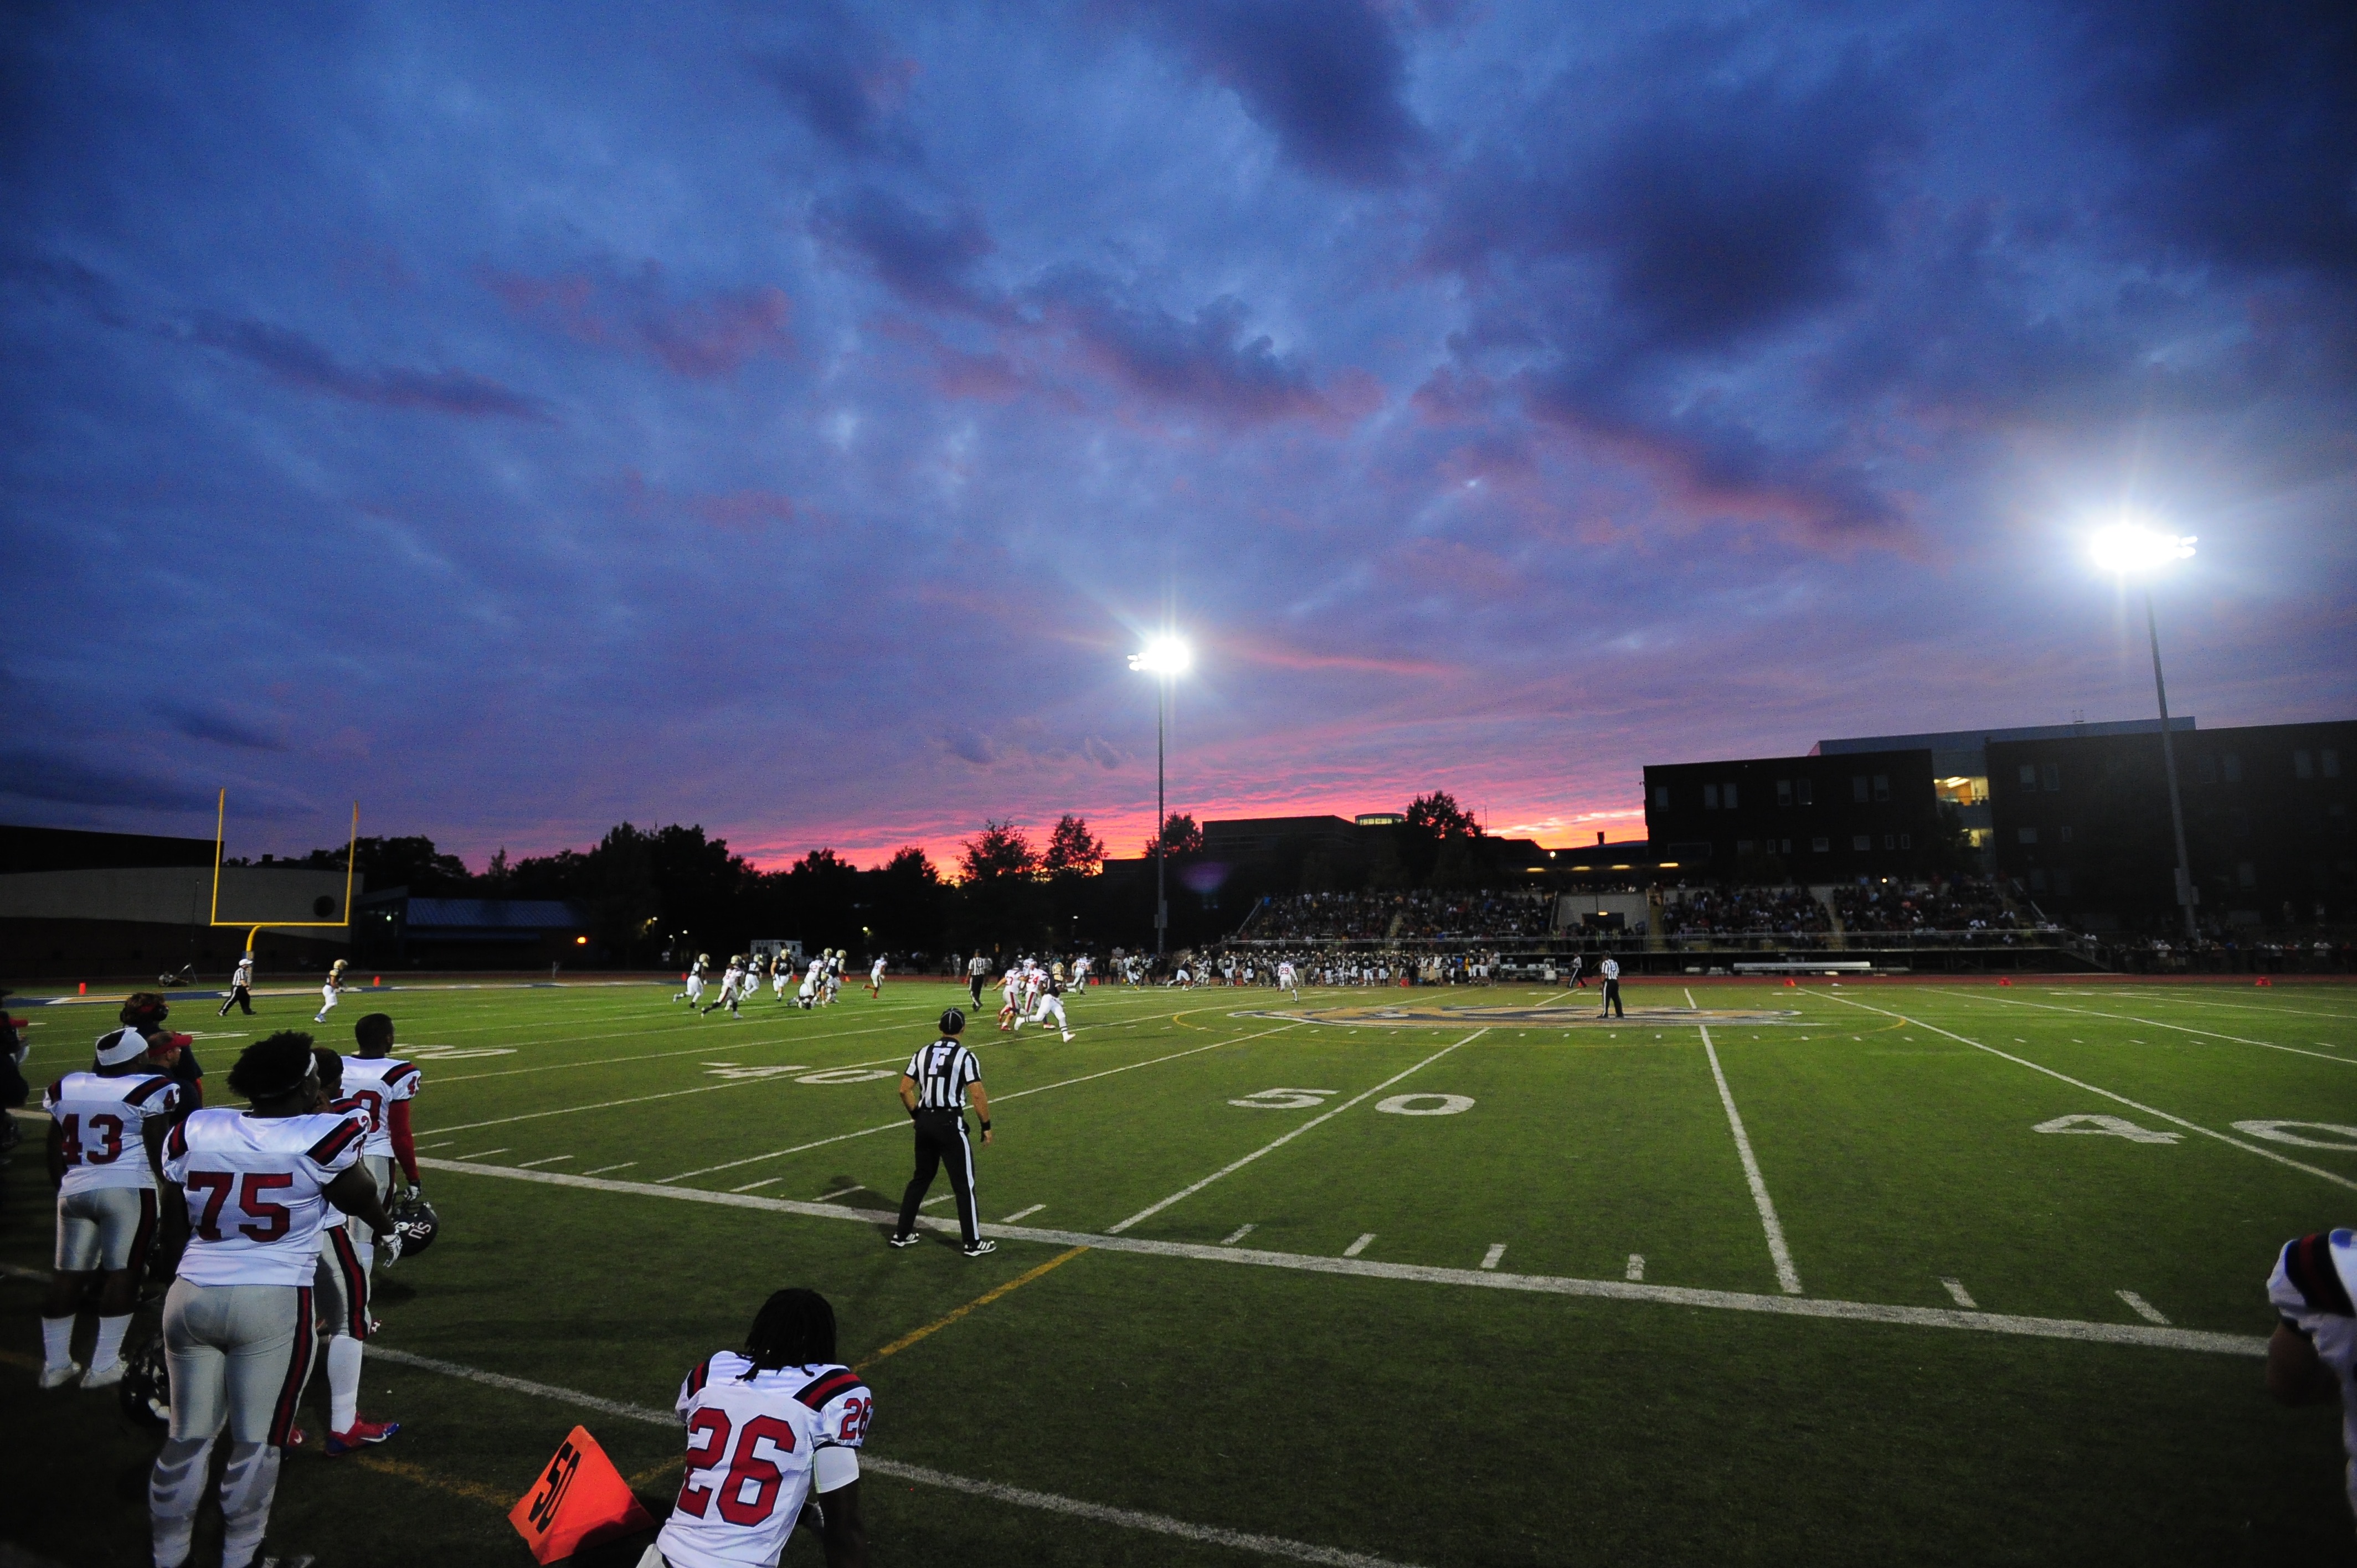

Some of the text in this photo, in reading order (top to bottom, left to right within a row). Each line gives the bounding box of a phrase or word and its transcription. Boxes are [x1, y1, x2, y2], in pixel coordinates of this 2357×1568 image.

[928, 1048, 952, 1075] F
[61, 1113, 123, 1165] 43
[187, 1170, 293, 1243] 75
[528, 1442, 581, 1534] 50
[676, 1406, 796, 1528] 26
